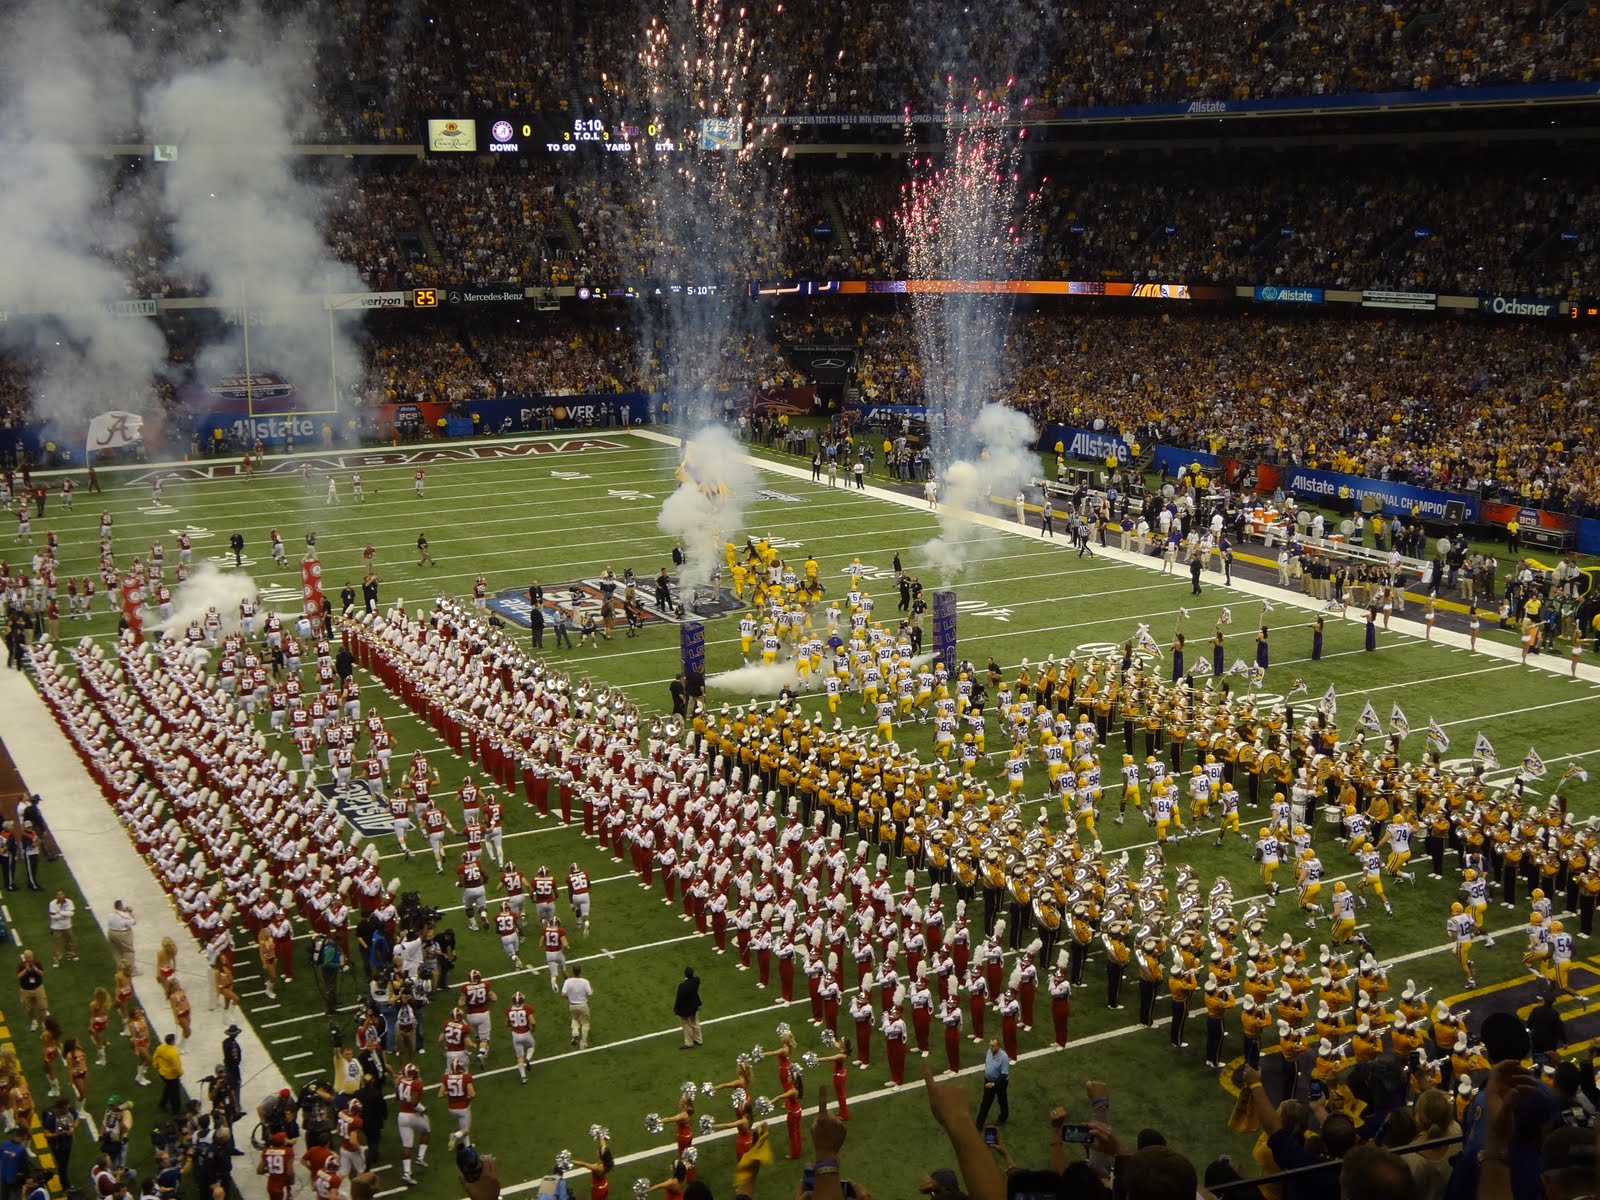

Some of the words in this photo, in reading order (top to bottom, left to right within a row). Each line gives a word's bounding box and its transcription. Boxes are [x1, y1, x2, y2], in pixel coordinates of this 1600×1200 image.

[1188, 101, 1226, 113] Allstate
[522, 125, 531, 137] 0
[574, 119, 602, 132] 5:10
[648, 124, 656, 136] 0
[564, 132, 570, 141] 3
[603, 132, 610, 141] 3
[489, 144, 518, 152] DOWN
[546, 144, 560, 152] TO
[562, 144, 576, 152] GO
[605, 143, 632, 151] YARD
[655, 143, 674, 152] QTR
[687, 286, 708, 295] 5:10
[1277, 289, 1313, 302] Allstate
[361, 296, 401, 307] verizon
[417, 291, 435, 305] 25
[463, 292, 524, 302] Mercedes-Benz
[1493, 297, 1550, 317] Ochsner
[1571, 307, 1578, 319] 3
[1070, 433, 1127, 462] Allstate
[124, 439, 631, 486] ALABAMA
[1291, 475, 1335, 495] Allstate
[1519, 516, 1537, 525] BCS
[880, 649, 891, 658] 97
[222, 662, 234, 672] 90
[242, 679, 254, 690] 67
[286, 683, 299, 694] 93
[830, 682, 835, 692] 9
[274, 695, 286, 706] 54
[325, 694, 337, 706] 70
[313, 704, 324, 716] 81
[883, 706, 892, 717] 98
[294, 711, 307, 722] 62
[941, 722, 952, 732] 83
[327, 731, 341, 743] 89
[375, 735, 389, 746] 74
[301, 740, 311, 751] 11
[339, 752, 352, 763] 44
[965, 747, 976, 757] 36
[1050, 748, 1062, 759] 78
[368, 763, 380, 775] 13
[417, 762, 427, 773] 19
[1013, 762, 1023, 774] 69
[1211, 768, 1220, 778] 81
[1062, 777, 1074, 788] 82
[415, 783, 428, 795] 31
[462, 790, 477, 802] 57
[392, 801, 406, 813] 50
[1158, 801, 1170, 812] 84
[428, 814, 442, 826] 48
[1352, 820, 1364, 833] 29
[469, 831, 481, 843] 16
[1396, 829, 1407, 841] 74
[1265, 843, 1277, 856] 95
[1369, 857, 1379, 870] 28
[464, 866, 481, 881] 76
[504, 876, 521, 891] 34
[536, 880, 553, 895] 55
[571, 874, 587, 890] 26
[1472, 884, 1484, 899] 35
[496, 916, 514, 931] 33
[1460, 922, 1471, 936] 12
[545, 931, 559, 946] 13
[1558, 938, 1572, 953] 54
[467, 988, 487, 1005] 79
[508, 1010, 527, 1027] 98
[445, 1027, 462, 1044] 23
[447, 1079, 465, 1097] 51
[266, 1155, 285, 1175] 19
